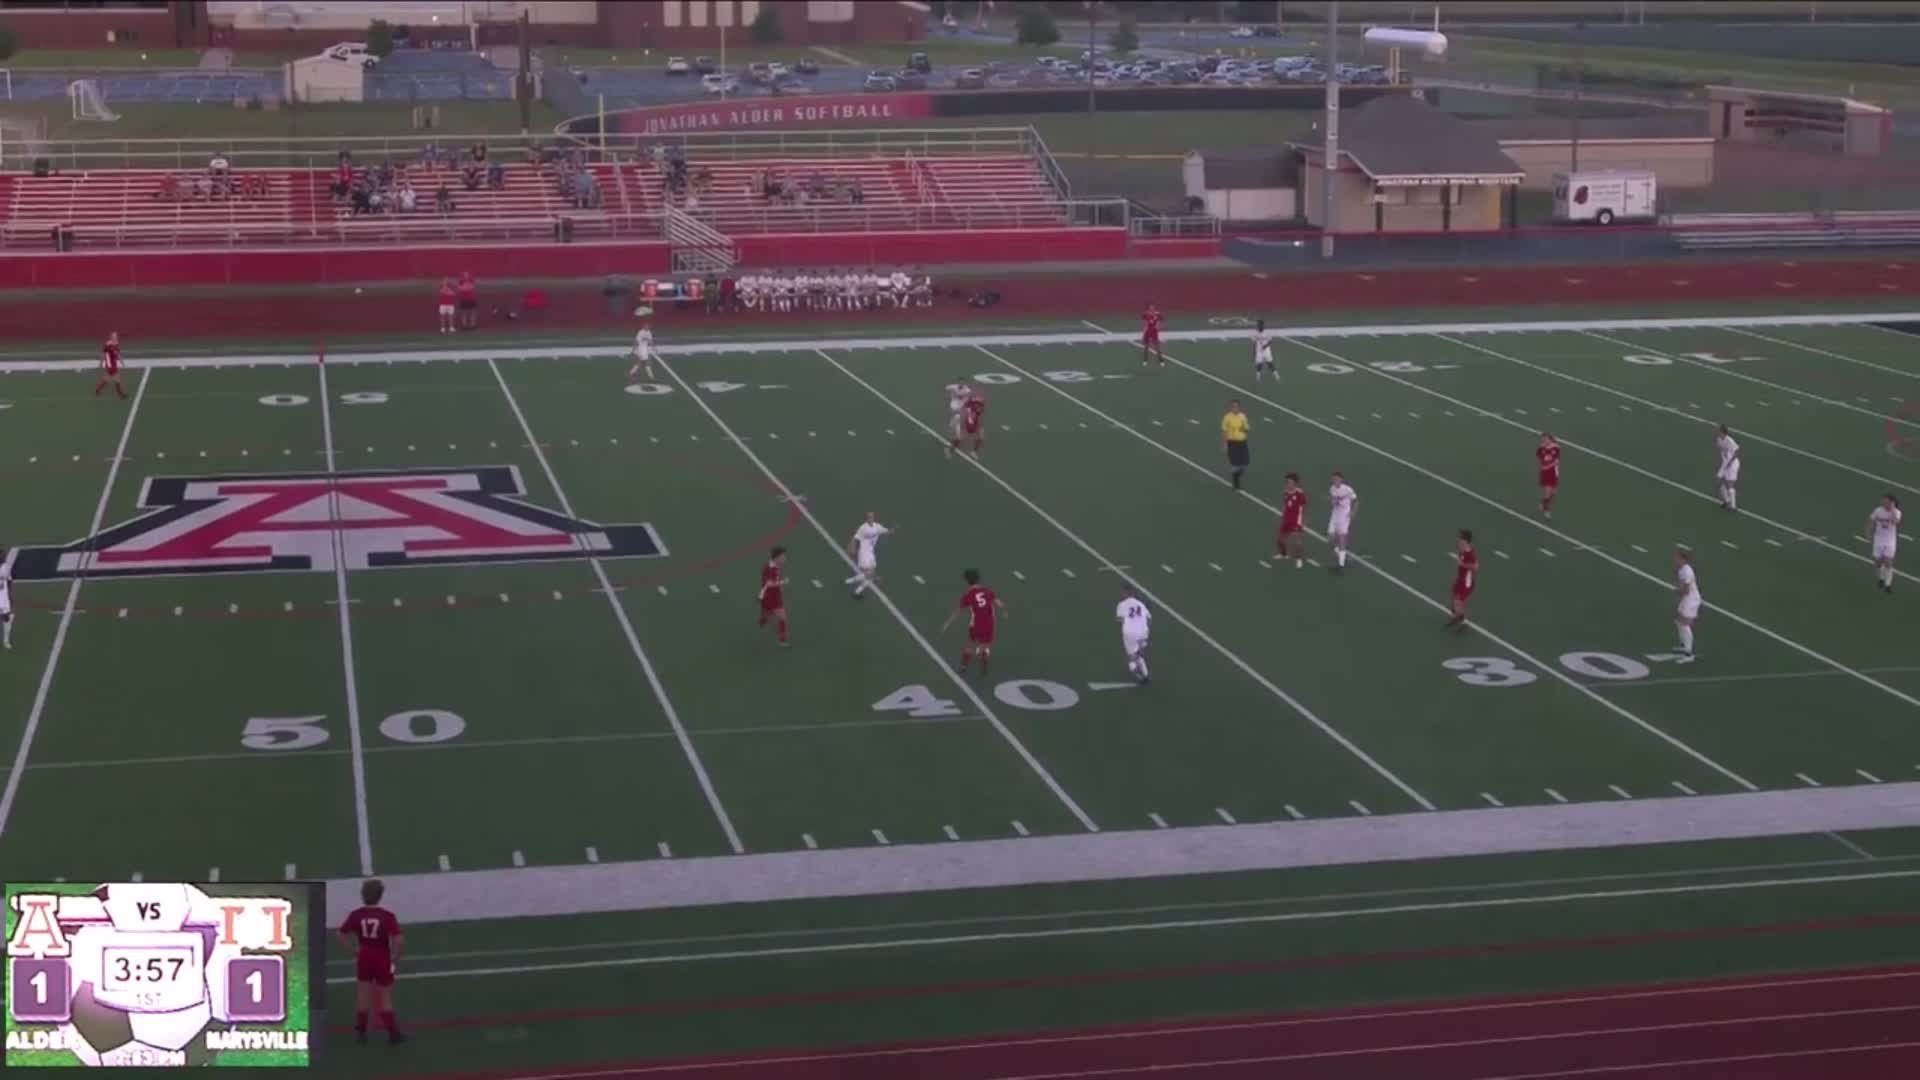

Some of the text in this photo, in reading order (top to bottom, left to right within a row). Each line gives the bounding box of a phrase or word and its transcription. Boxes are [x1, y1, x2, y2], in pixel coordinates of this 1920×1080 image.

[644, 104, 892, 133] JONATHAN ALDER SOFTBALL
[975, 592, 987, 608] 5
[1128, 605, 1142, 619] 24
[360, 918, 380, 939] 17
